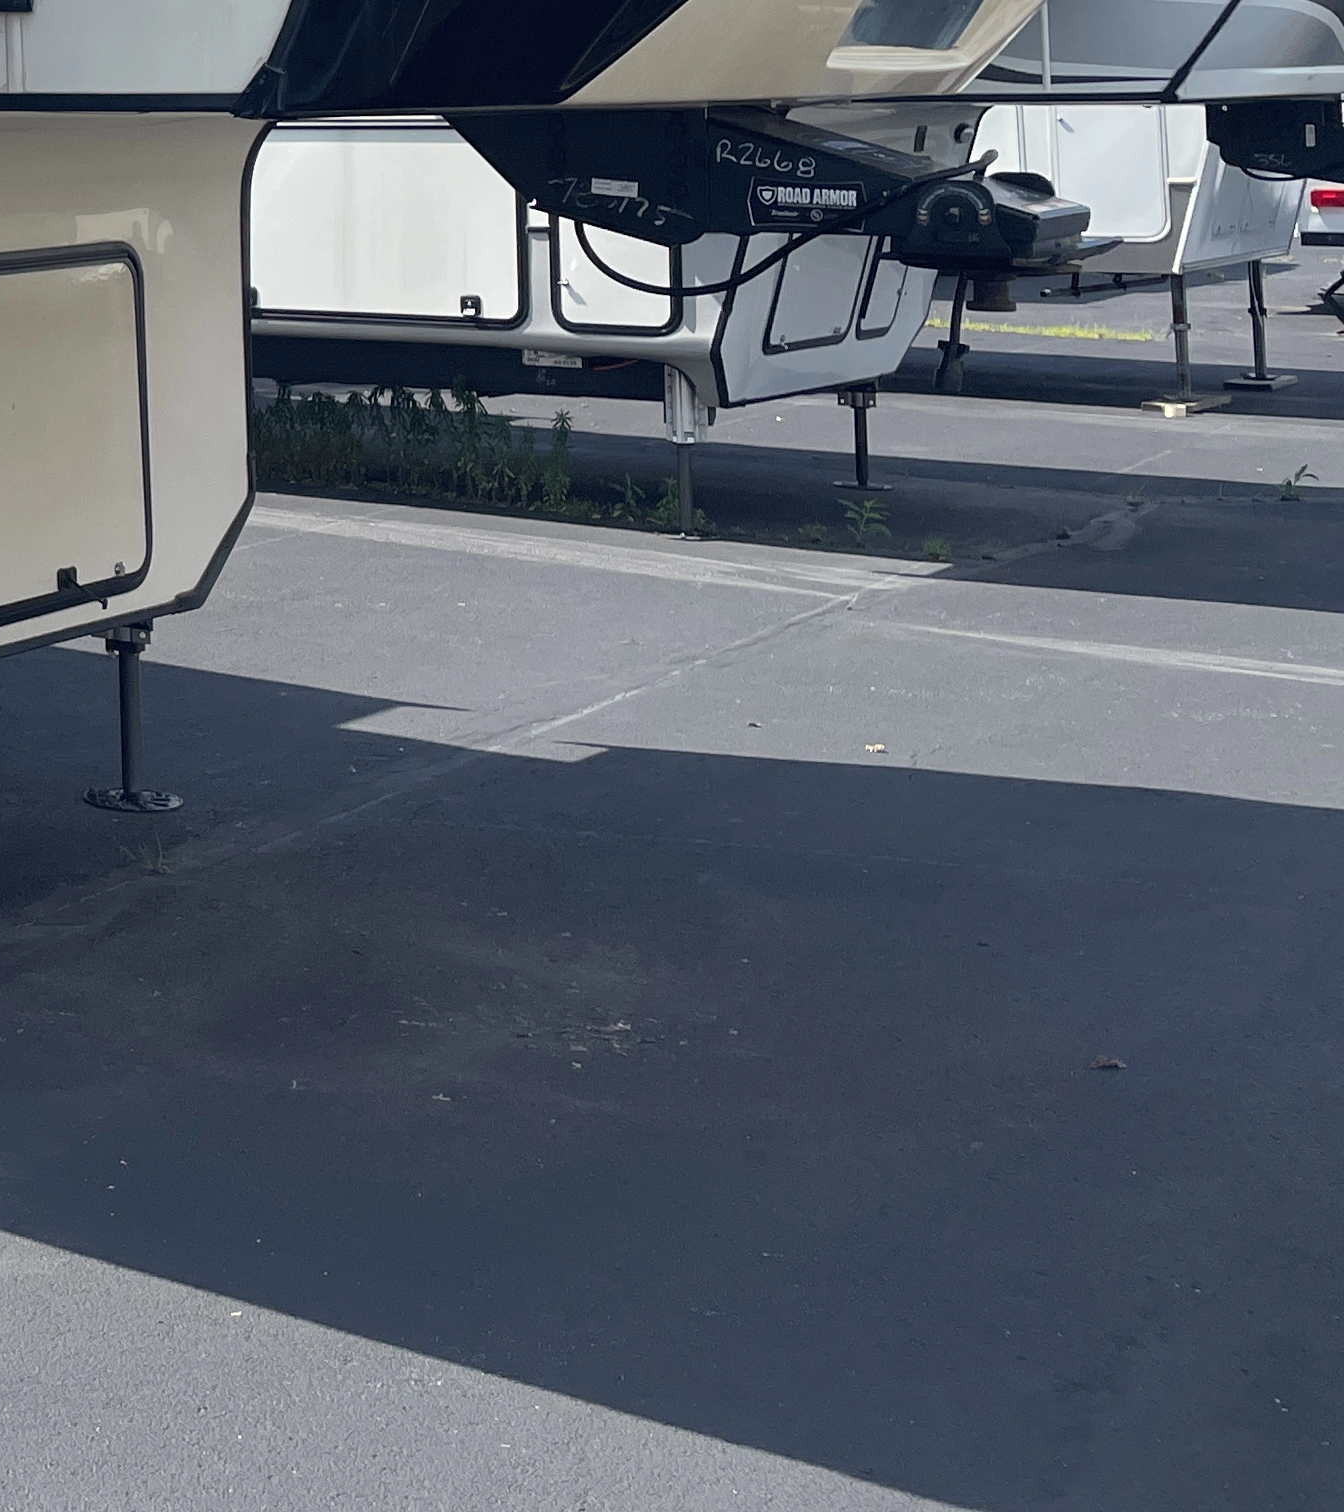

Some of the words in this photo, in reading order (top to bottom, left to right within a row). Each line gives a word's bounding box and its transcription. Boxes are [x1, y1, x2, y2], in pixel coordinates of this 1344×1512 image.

[715, 139, 816, 178] R2668
[777, 186, 811, 204] ROAD
[813, 188, 857, 207] ARMOR
